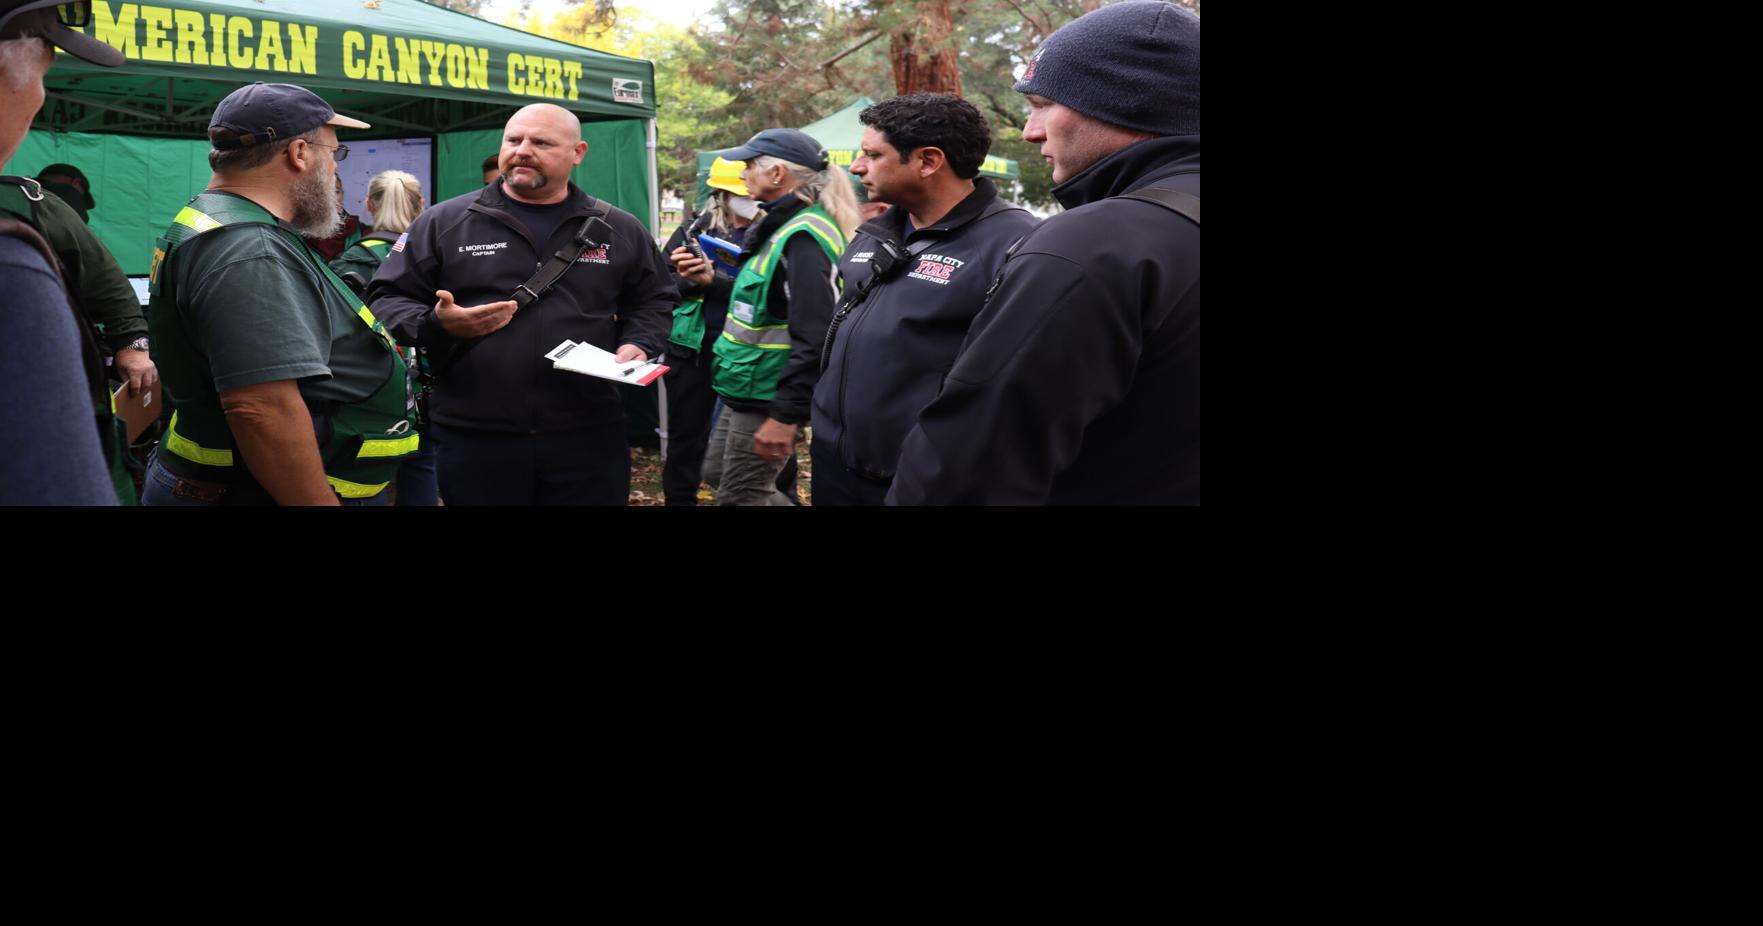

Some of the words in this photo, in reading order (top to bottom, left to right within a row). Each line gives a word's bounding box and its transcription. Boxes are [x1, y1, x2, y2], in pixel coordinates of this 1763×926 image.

[343, 30, 490, 91] CANYON
[507, 52, 583, 101] CERT
[465, 242, 508, 251] MORTIMORE
[919, 254, 941, 262] NAPA
[942, 256, 965, 268] CITY
[914, 261, 955, 280] FIRE
[907, 271, 950, 285] DEPARTMENT
